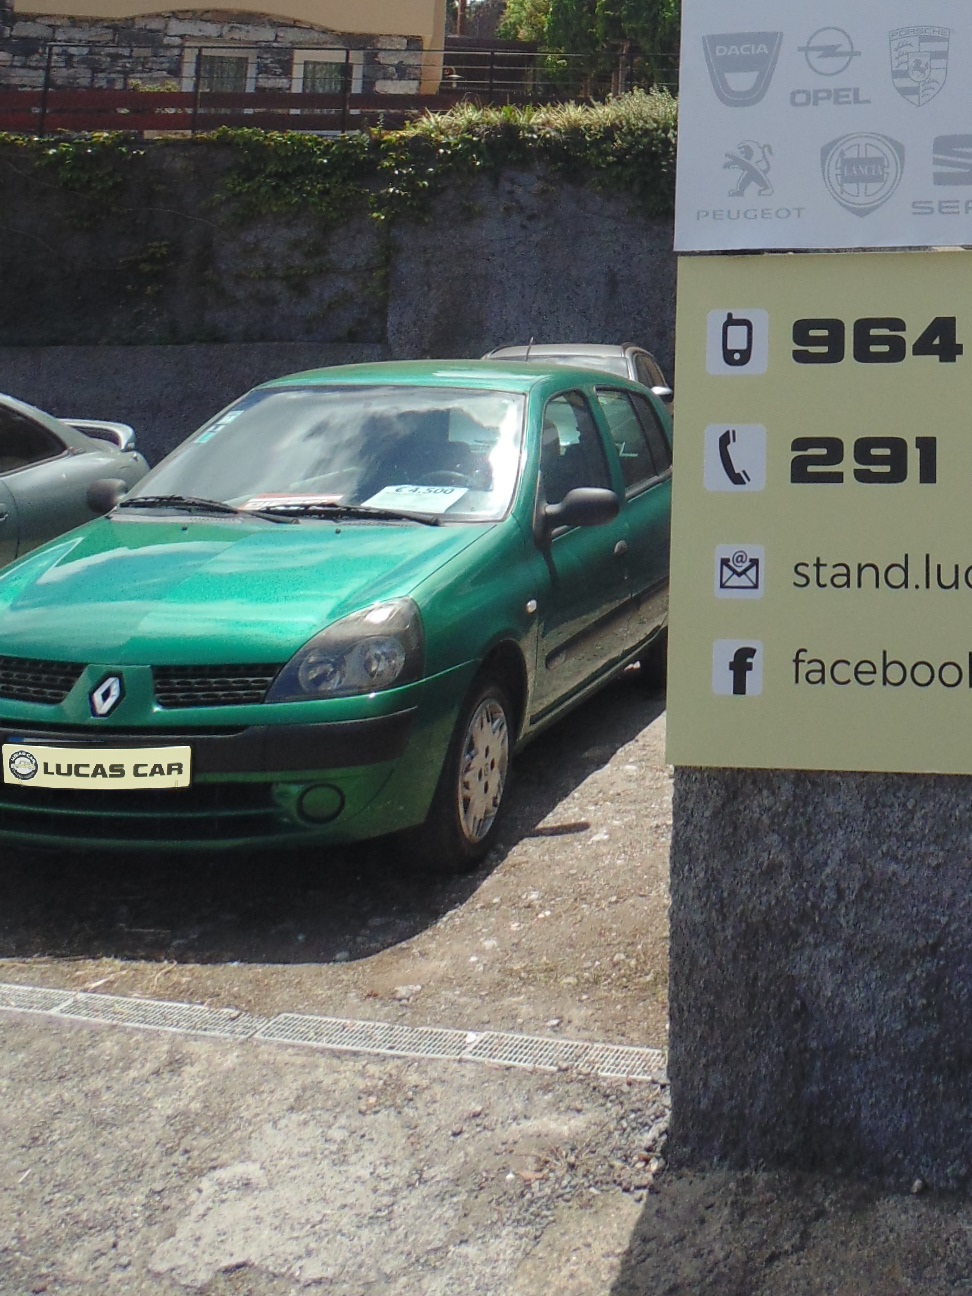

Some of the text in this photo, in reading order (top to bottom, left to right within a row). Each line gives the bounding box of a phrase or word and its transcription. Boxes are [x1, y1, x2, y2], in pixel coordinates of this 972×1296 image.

[715, 43, 769, 56] DACIA
[789, 87, 872, 107] OPEL
[696, 207, 806, 222] PEUGEOT
[791, 316, 964, 365] 964
[789, 436, 938, 485] 291
[43, 761, 126, 779] LUCAS
[132, 762, 184, 777] CAR
